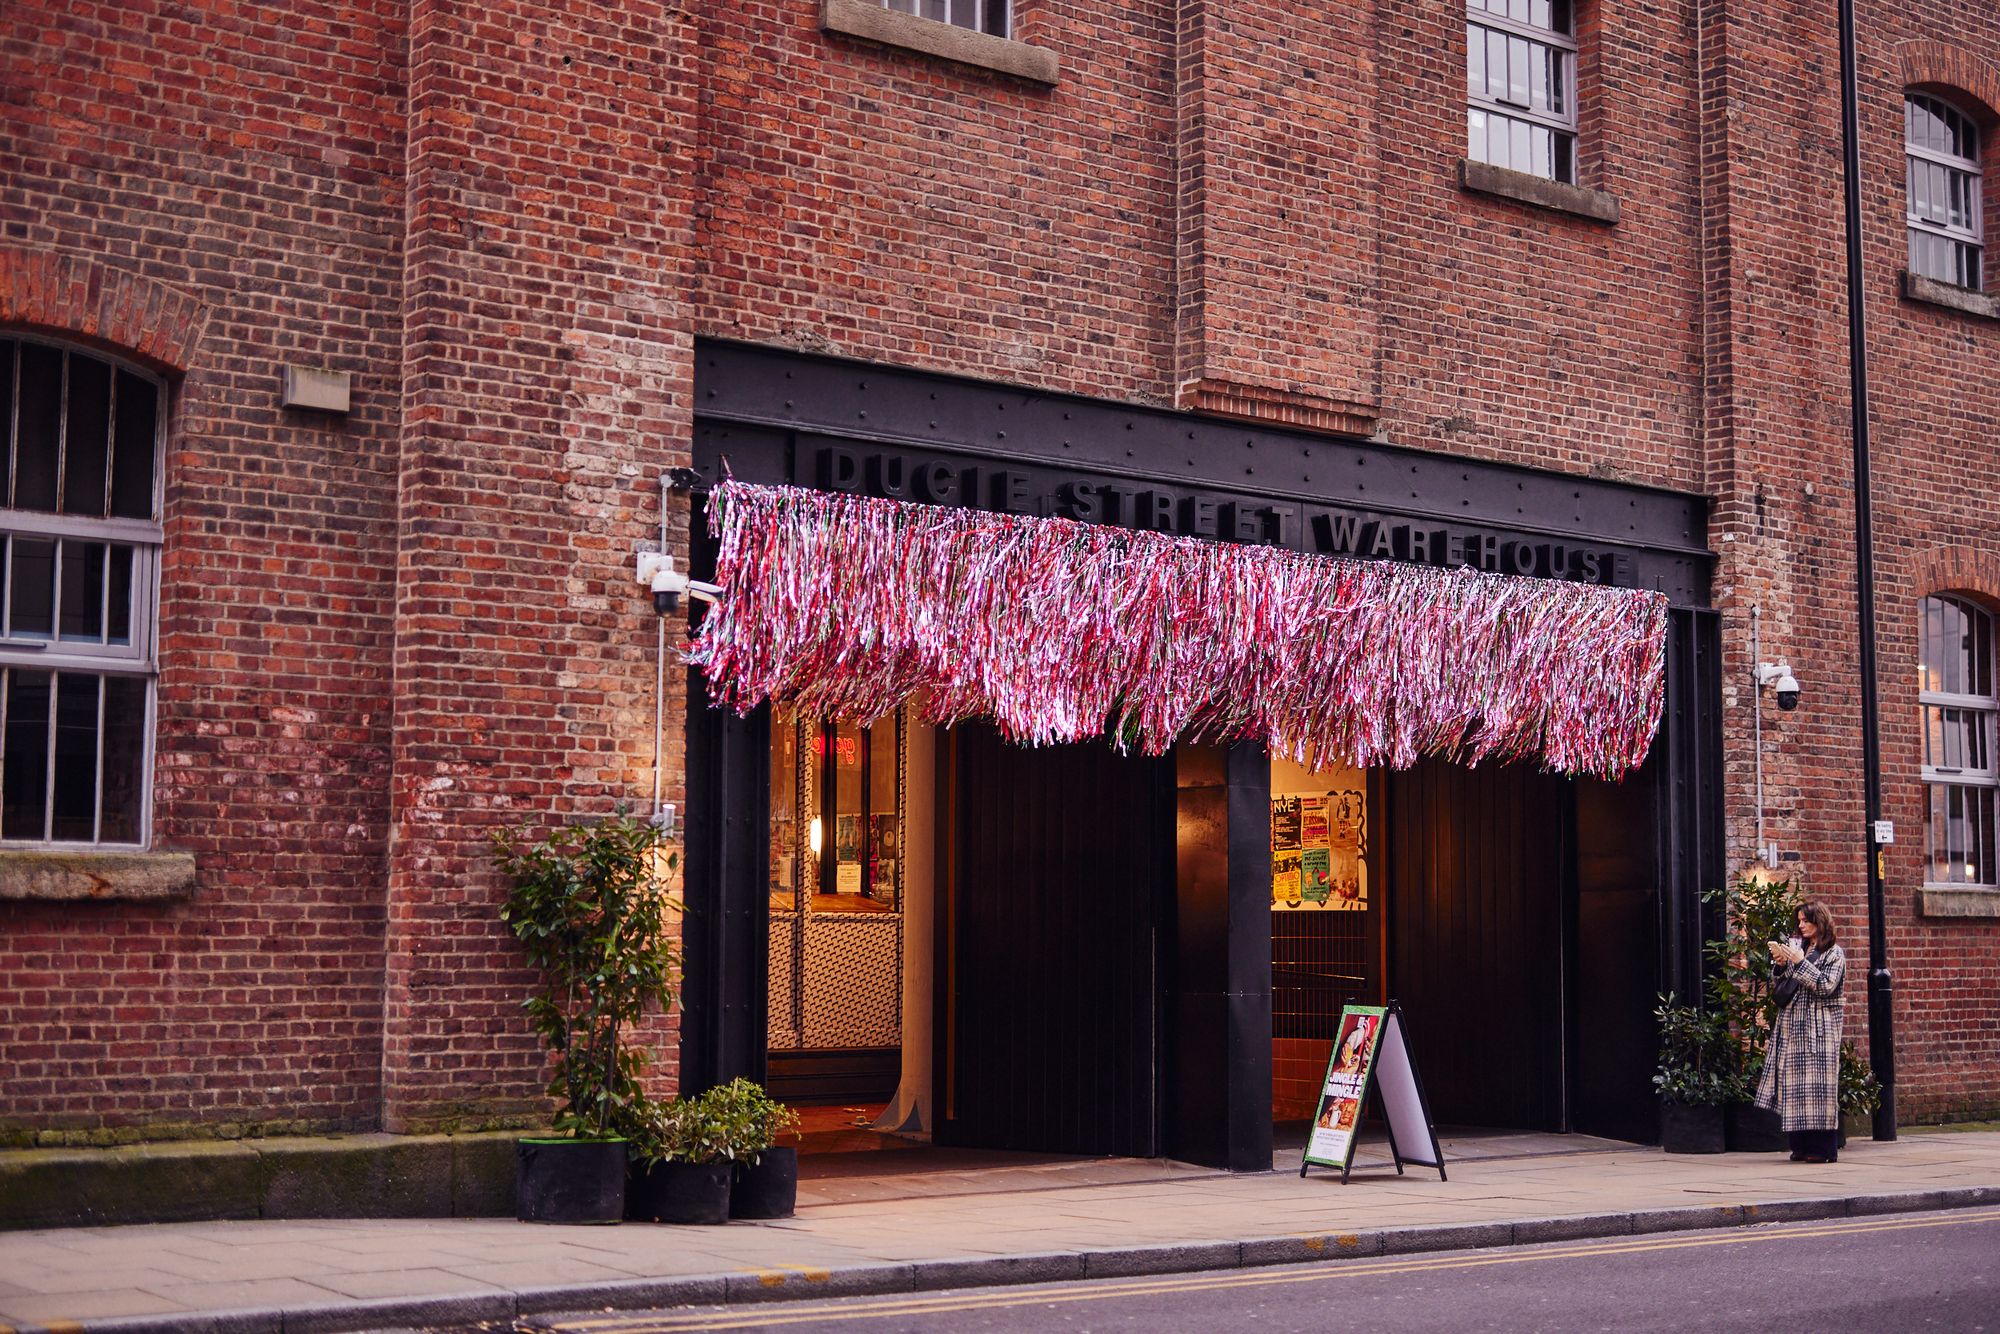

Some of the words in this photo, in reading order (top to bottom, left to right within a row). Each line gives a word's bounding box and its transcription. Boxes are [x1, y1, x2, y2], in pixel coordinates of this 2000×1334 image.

[823, 446, 1031, 513] DUCIE
[1064, 478, 1294, 545] STREET
[1318, 512, 1632, 586] WAREHOUSE
[1273, 799, 1296, 813] NYE
[1329, 1071, 1358, 1085] JINGLE
[1325, 1083, 1362, 1099] MINGLE
